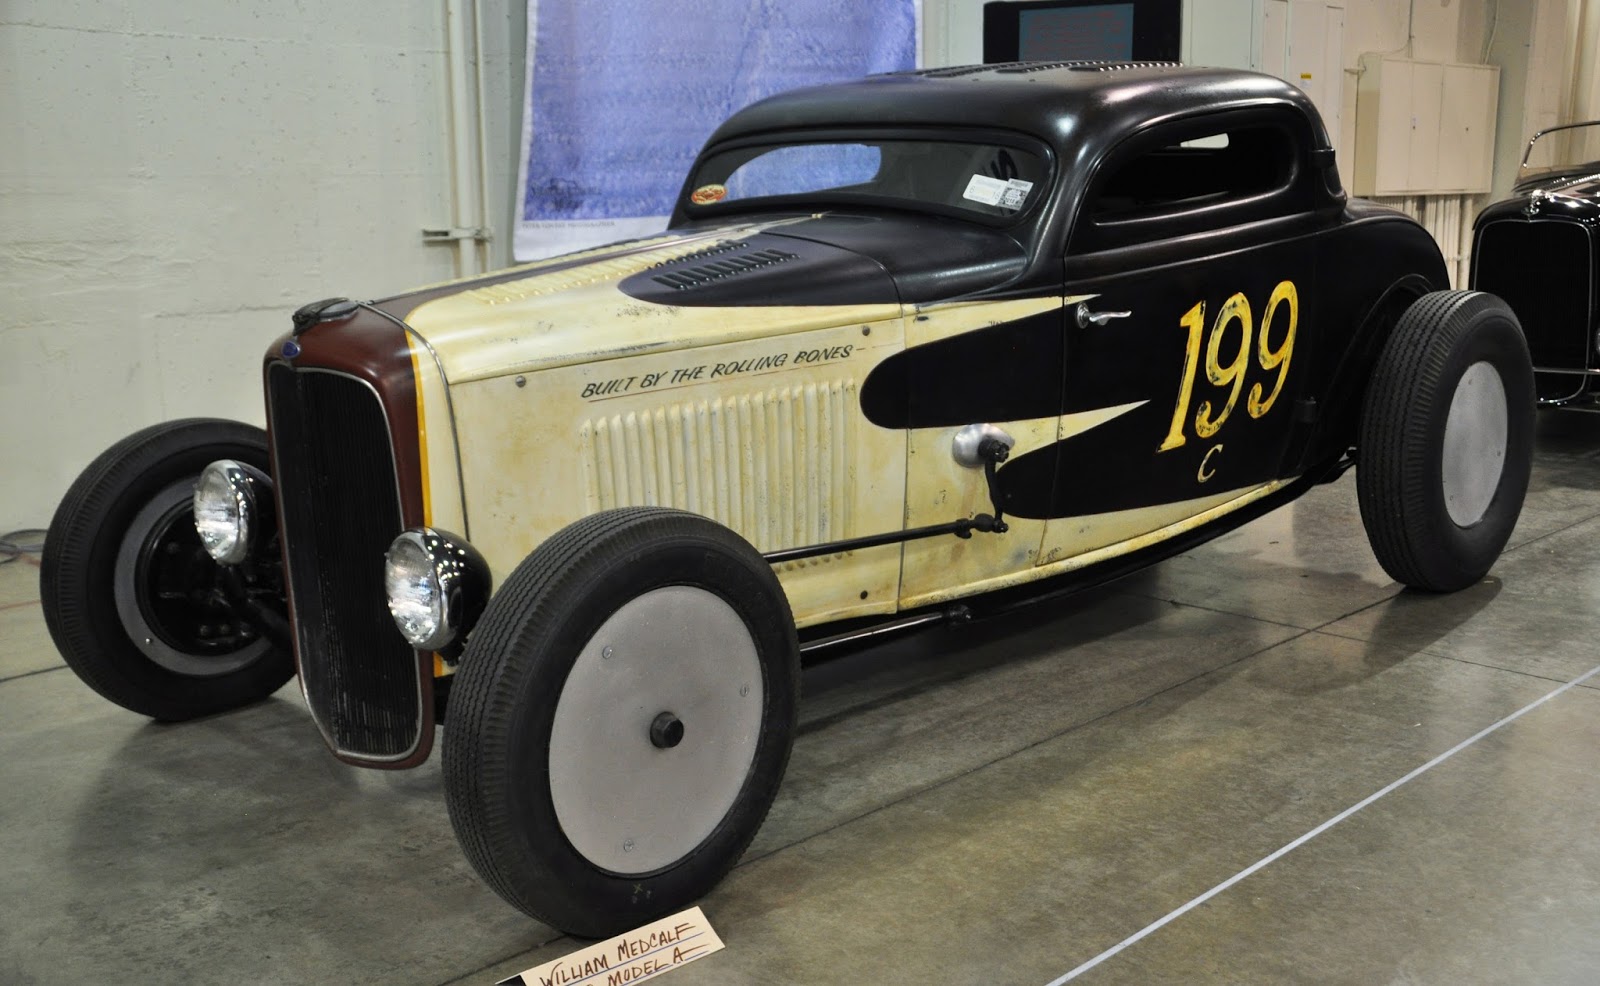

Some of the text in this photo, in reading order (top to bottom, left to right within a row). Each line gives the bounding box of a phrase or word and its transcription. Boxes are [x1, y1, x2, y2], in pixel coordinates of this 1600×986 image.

[580, 344, 854, 399] BUILT BY THE ROLLING BONES
[1155, 279, 1299, 453] 199
[1197, 444, 1224, 483] C
[539, 922, 696, 986] WILLIAM MEDCALF
[607, 958, 670, 986] MODEL
